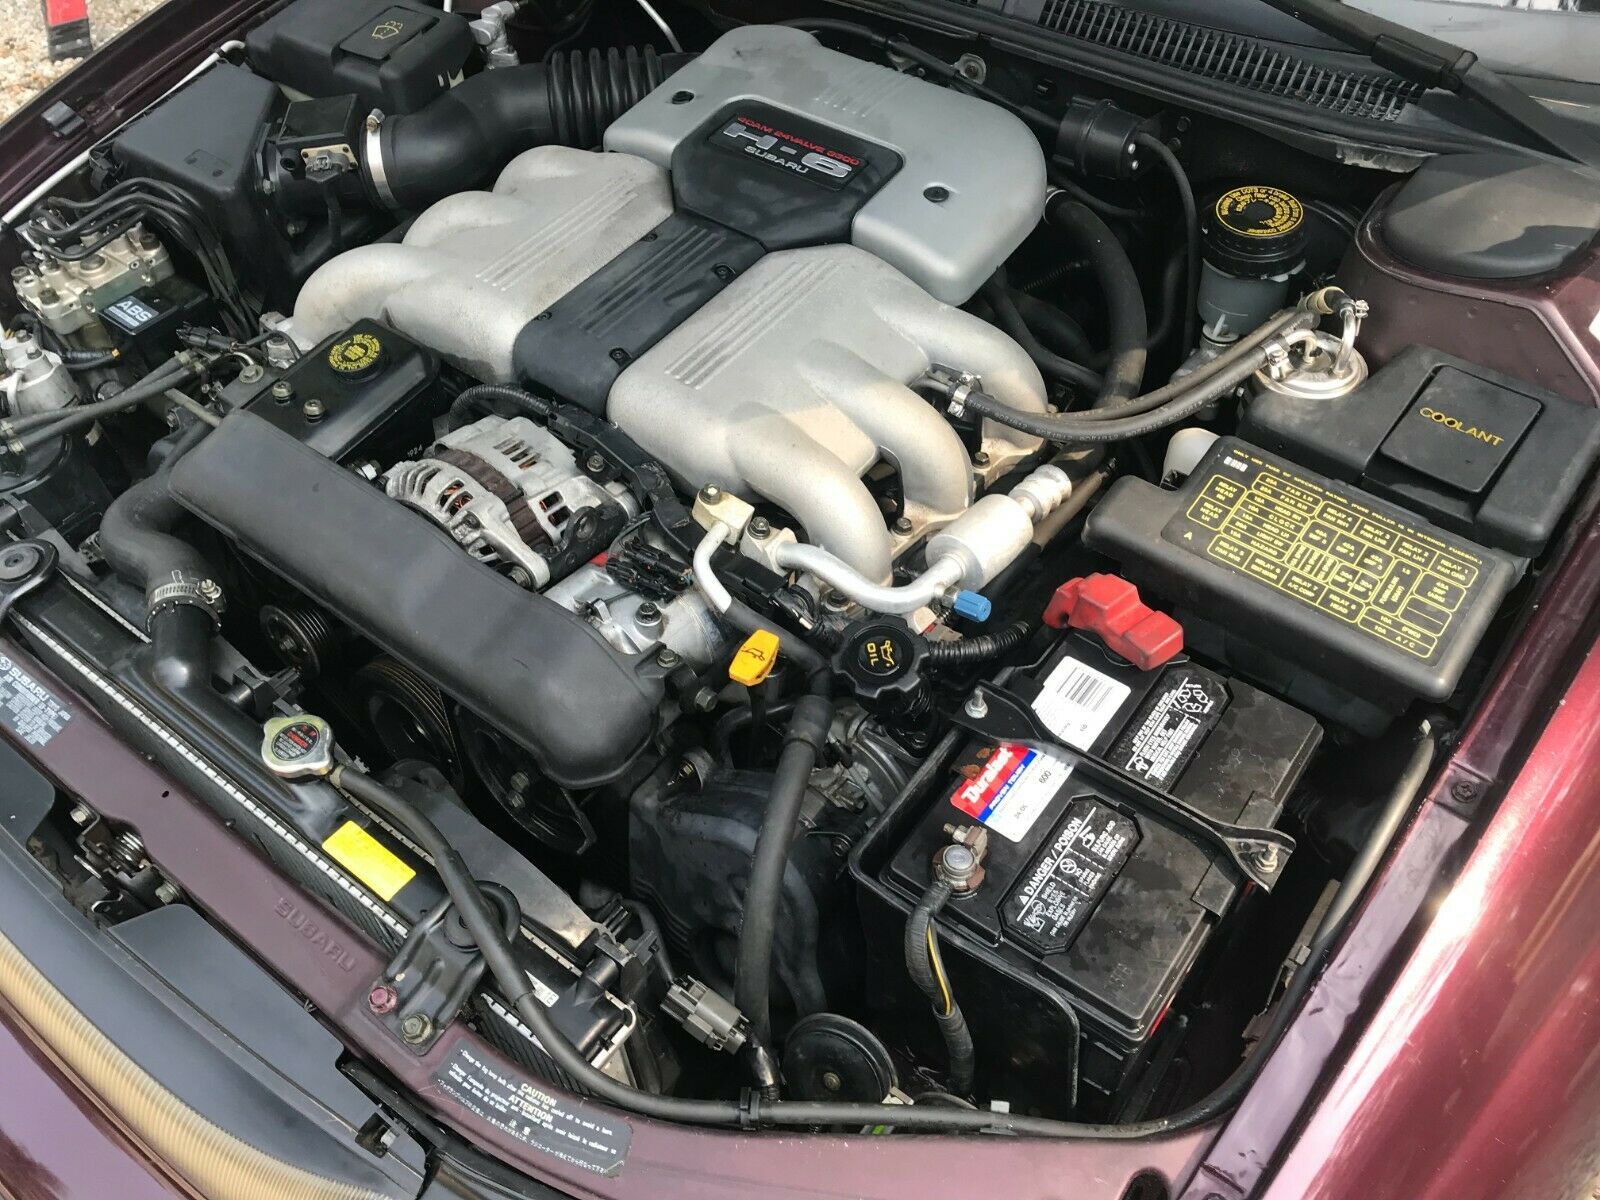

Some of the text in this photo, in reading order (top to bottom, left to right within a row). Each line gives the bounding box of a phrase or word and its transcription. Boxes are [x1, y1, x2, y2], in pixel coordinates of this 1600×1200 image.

[723, 122, 852, 178] H-6
[744, 146, 809, 174] SUBARU
[116, 300, 152, 322] ABS
[1420, 407, 1504, 446] COOLANT
[1215, 486, 1233, 498] HEAD
[1219, 482, 1237, 492] RELAY
[1286, 486, 1301, 496] FAN
[1303, 494, 1313, 502] LH
[1204, 502, 1223, 513] RELAY
[1280, 495, 1295, 505] FAN
[1297, 502, 1308, 510] RH
[1200, 507, 1219, 519] HEAD
[1275, 505, 1291, 516] HEAD
[1327, 507, 1346, 518] RELAY
[1263, 523, 1279, 534] HEAD
[1268, 515, 1295, 530] CLOCK
[1364, 524, 1384, 536] RELAY
[1219, 540, 1238, 553] RELAY
[1250, 540, 1278, 556] HAZARD
[1398, 548, 1412, 557] FAN
[1402, 542, 1422, 554] RELAY
[1255, 558, 1274, 570] RELAY
[1441, 559, 1462, 571] RELAY
[1291, 576, 1311, 588] RELAY
[1329, 594, 1349, 606] RELAY
[1330, 602, 1348, 613] HEAD
[867, 642, 878, 666] OIL
[9, 667, 50, 701] SUBARU
[961, 747, 1013, 804] Duralast
[1024, 856, 1055, 896] DANGER
[1054, 817, 1083, 852] POISON
[1073, 867, 1083, 877] NO
[1040, 880, 1056, 899] SHIELD
[275, 898, 355, 972] SUBARU
[520, 1083, 557, 1107] CAUTION
[508, 1094, 553, 1122] ATTENTION
